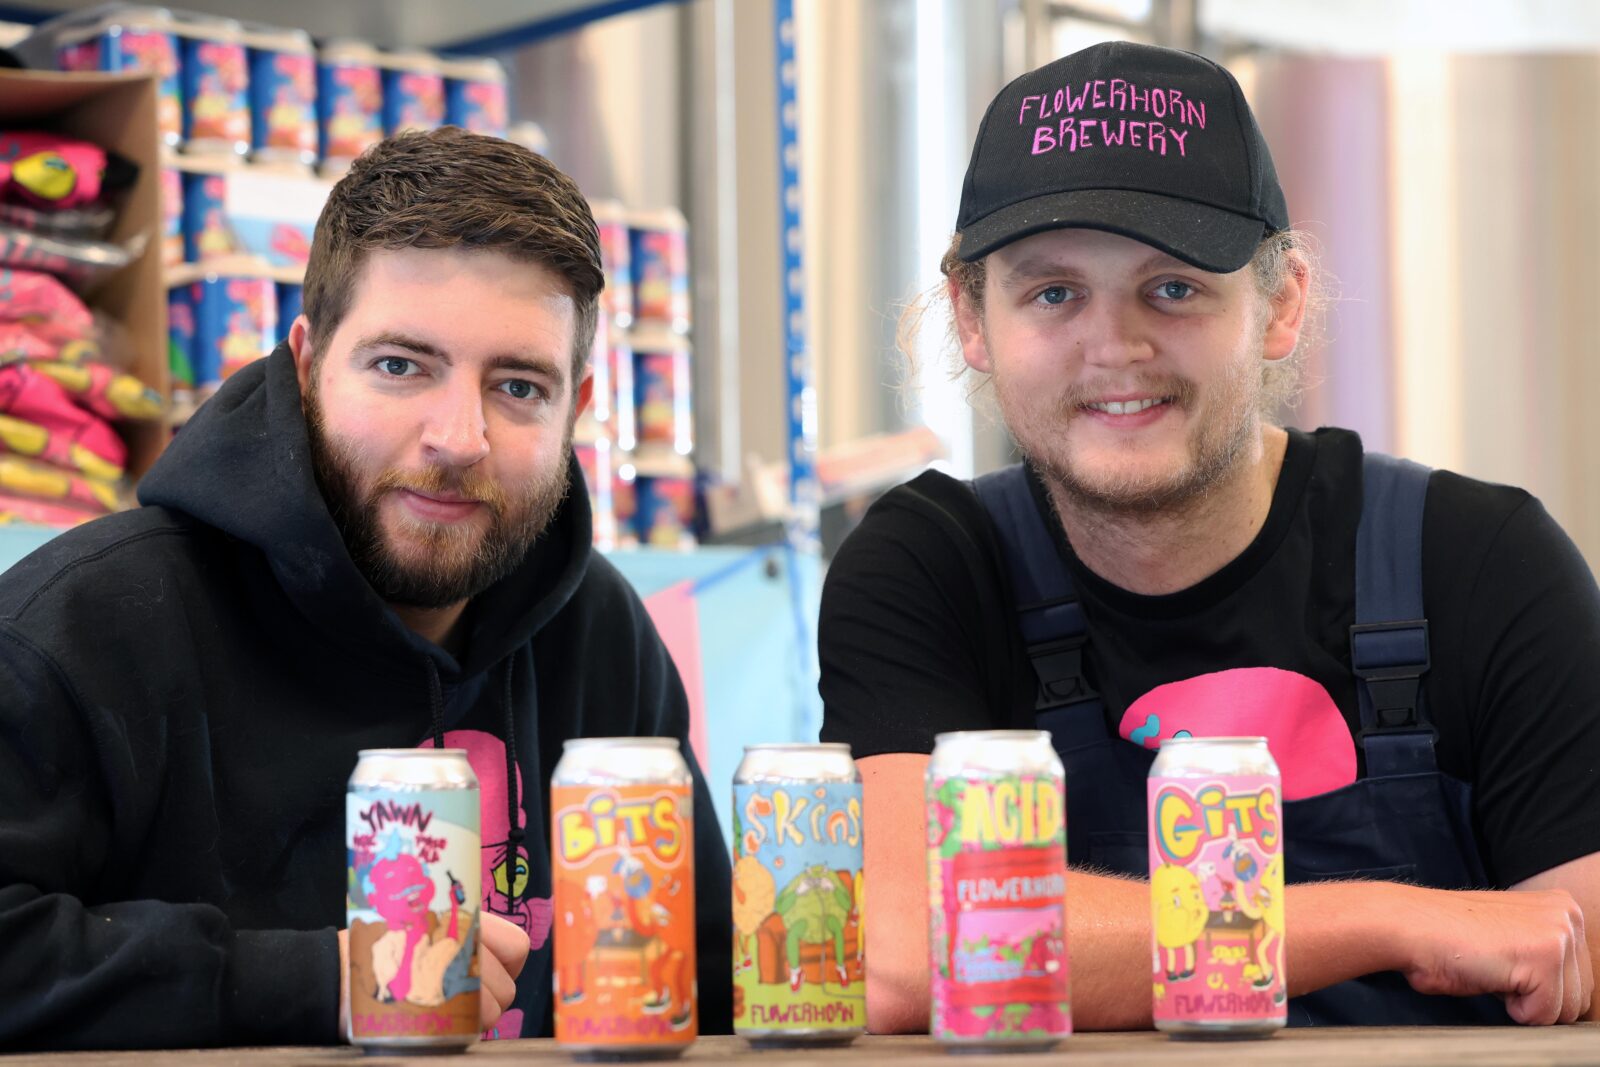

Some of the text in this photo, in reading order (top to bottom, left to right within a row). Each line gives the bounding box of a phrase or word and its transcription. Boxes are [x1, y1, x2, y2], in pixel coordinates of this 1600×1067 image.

[1019, 78, 1206, 130] FLOWERHORN
[1031, 116, 1188, 157] BREWERY
[359, 799, 433, 833] YAWN
[960, 781, 1061, 843] ACID
[751, 1001, 855, 1025] FLOWERHORN
